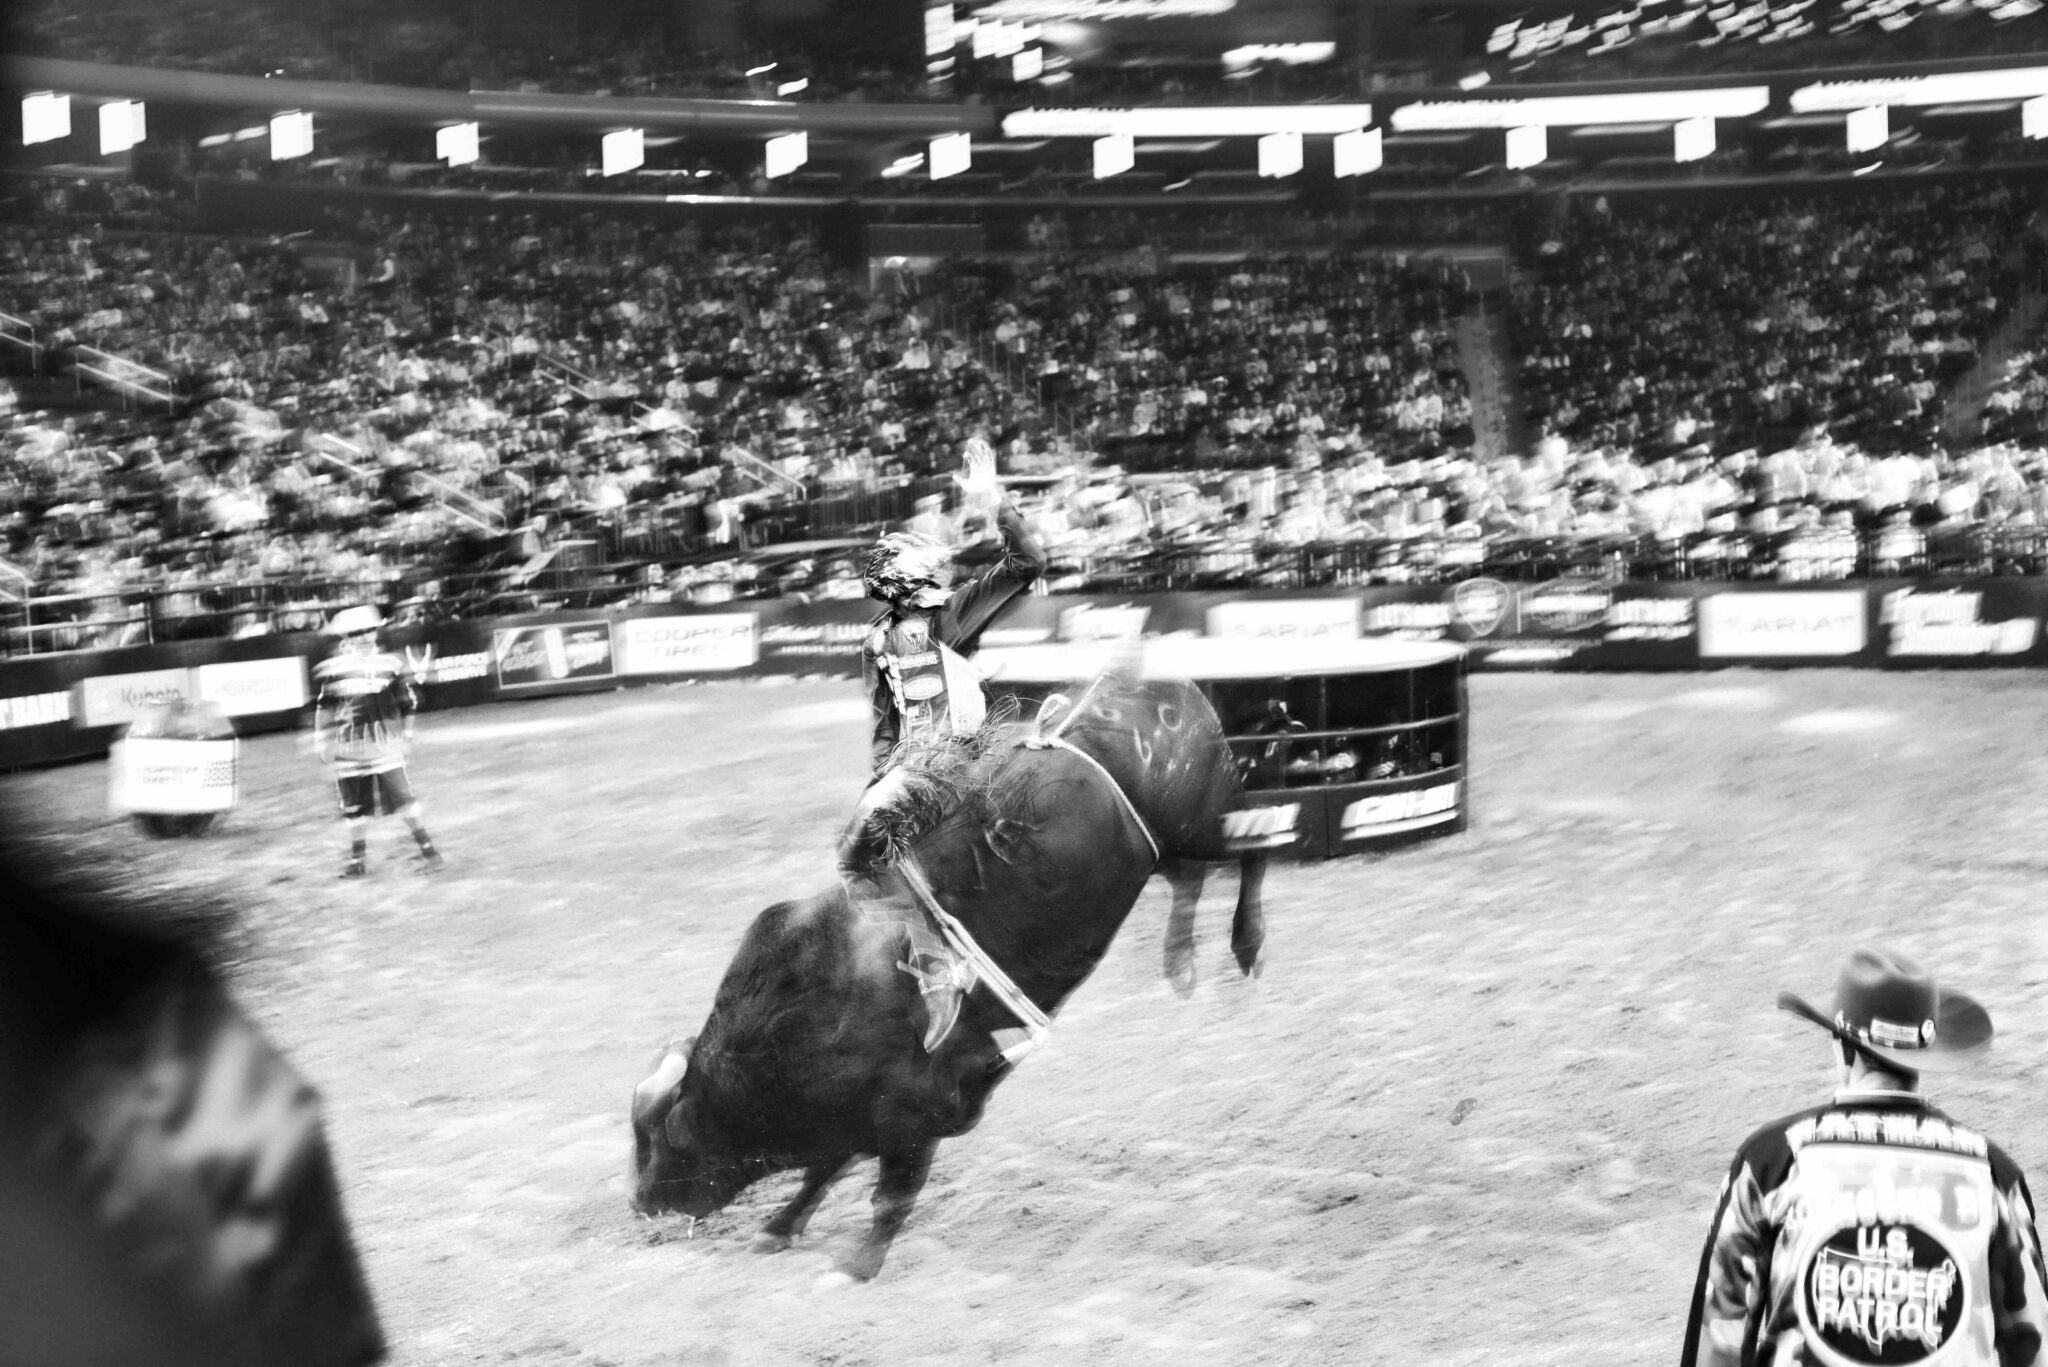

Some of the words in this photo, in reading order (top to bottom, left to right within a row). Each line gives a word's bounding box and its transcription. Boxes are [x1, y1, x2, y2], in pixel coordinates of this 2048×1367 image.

[634, 624, 750, 643] COOPER
[1857, 1226, 1914, 1265] U.S.
[1818, 1263, 1950, 1307] BORDER
[1817, 1295, 1943, 1340] PATROL
